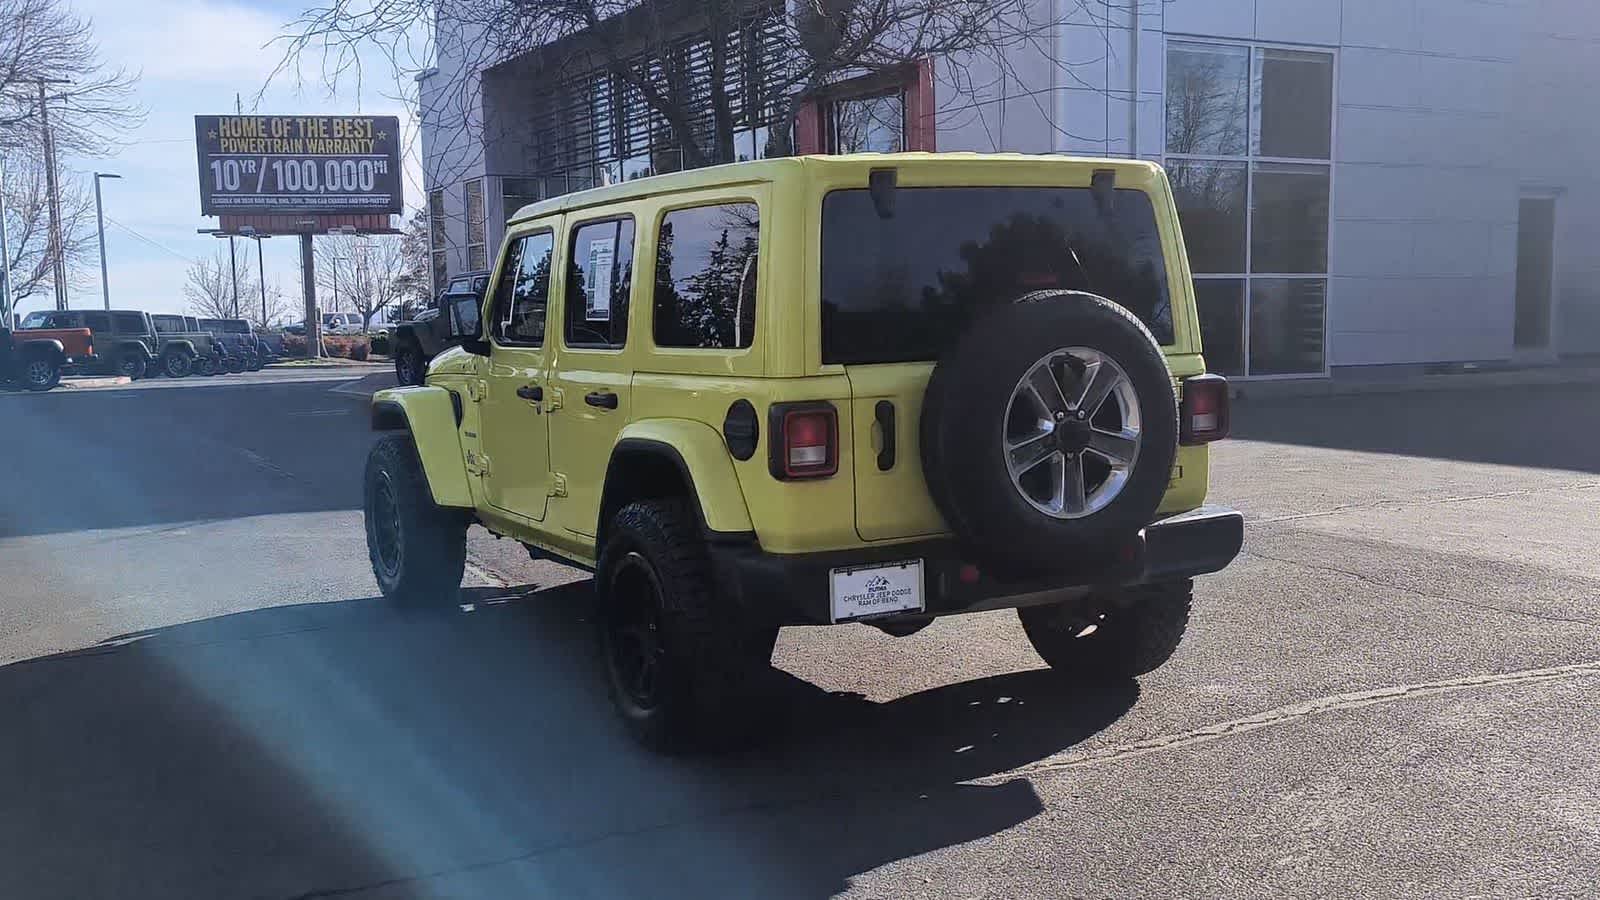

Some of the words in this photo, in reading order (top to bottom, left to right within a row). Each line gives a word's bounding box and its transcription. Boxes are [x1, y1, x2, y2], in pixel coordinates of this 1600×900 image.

[219, 117, 267, 137] HOME
[271, 117, 292, 137] OF
[295, 118, 329, 138] THE
[332, 118, 374, 138] BEST
[220, 138, 303, 153] POWERTRAIN
[306, 139, 375, 154] WARRANTY
